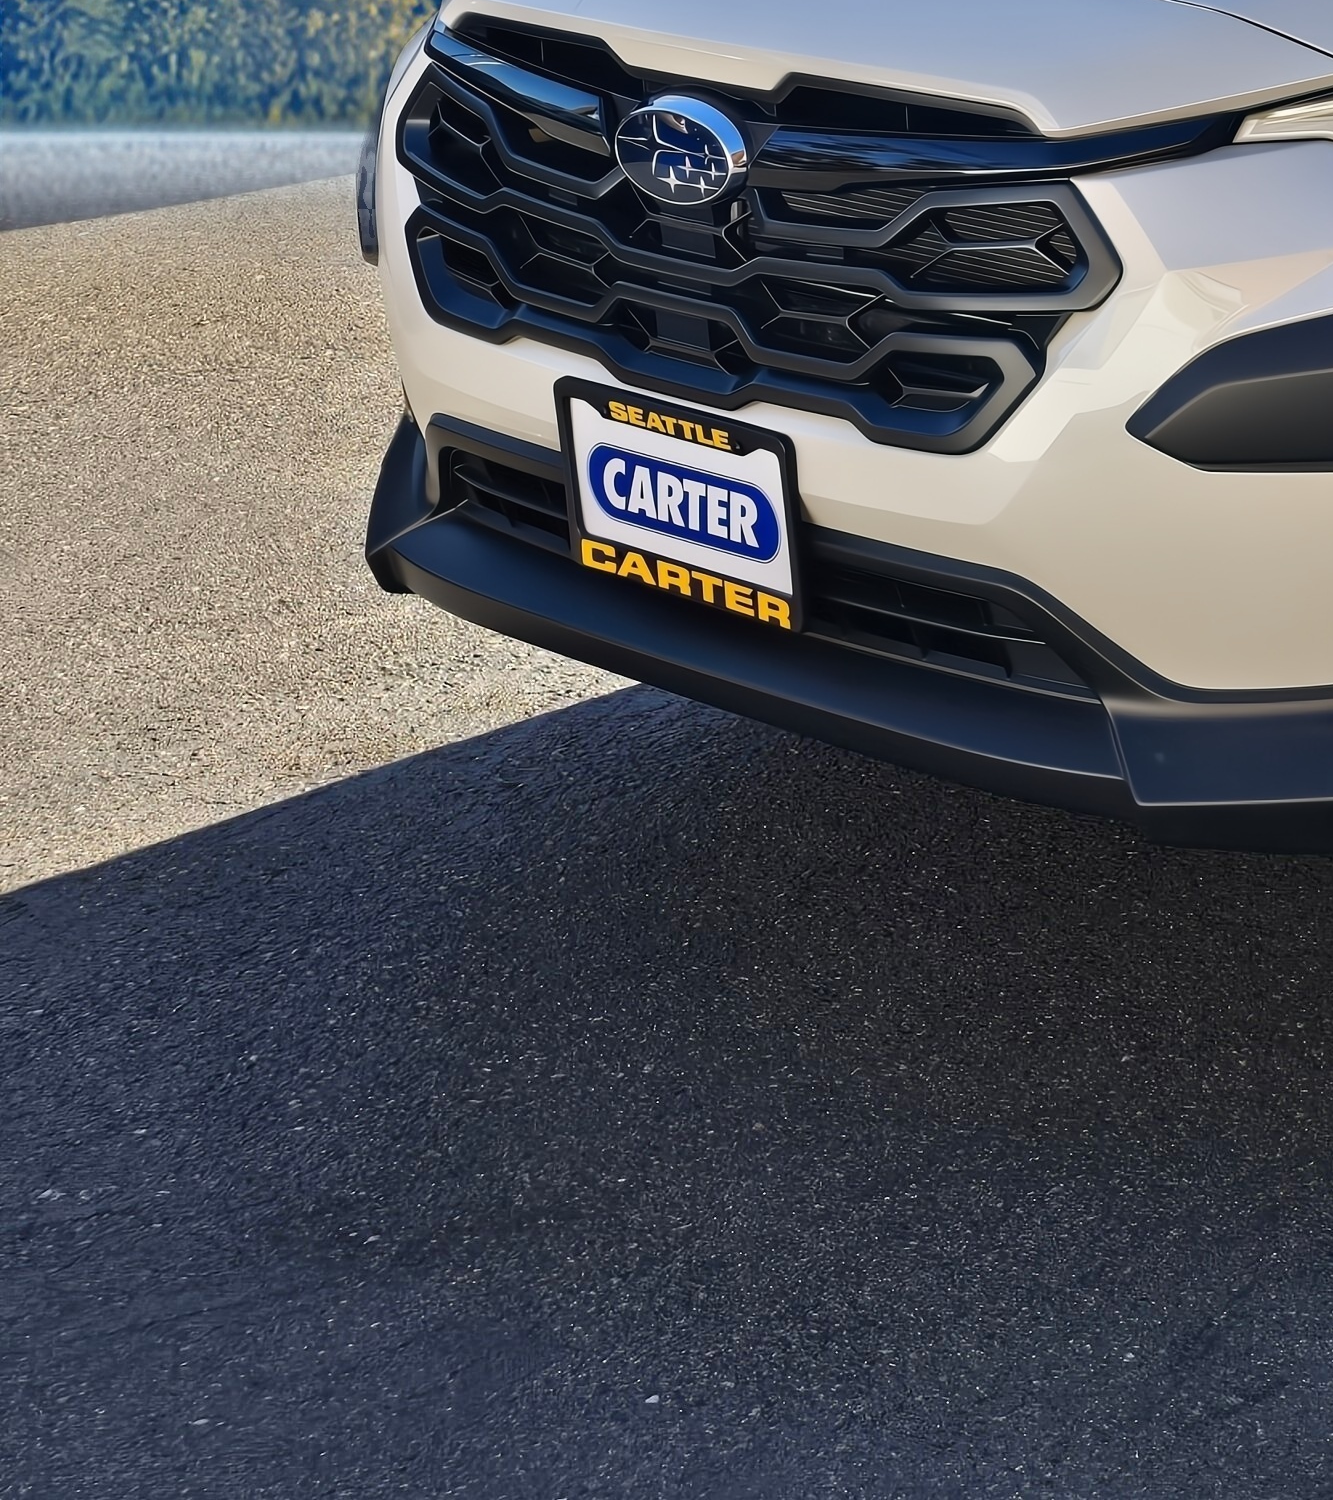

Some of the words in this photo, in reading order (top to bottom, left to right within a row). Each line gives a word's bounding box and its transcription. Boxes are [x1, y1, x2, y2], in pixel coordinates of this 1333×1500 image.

[608, 401, 732, 450] SEATTLE
[602, 457, 759, 548] CARTER
[580, 538, 792, 630] CARTER
